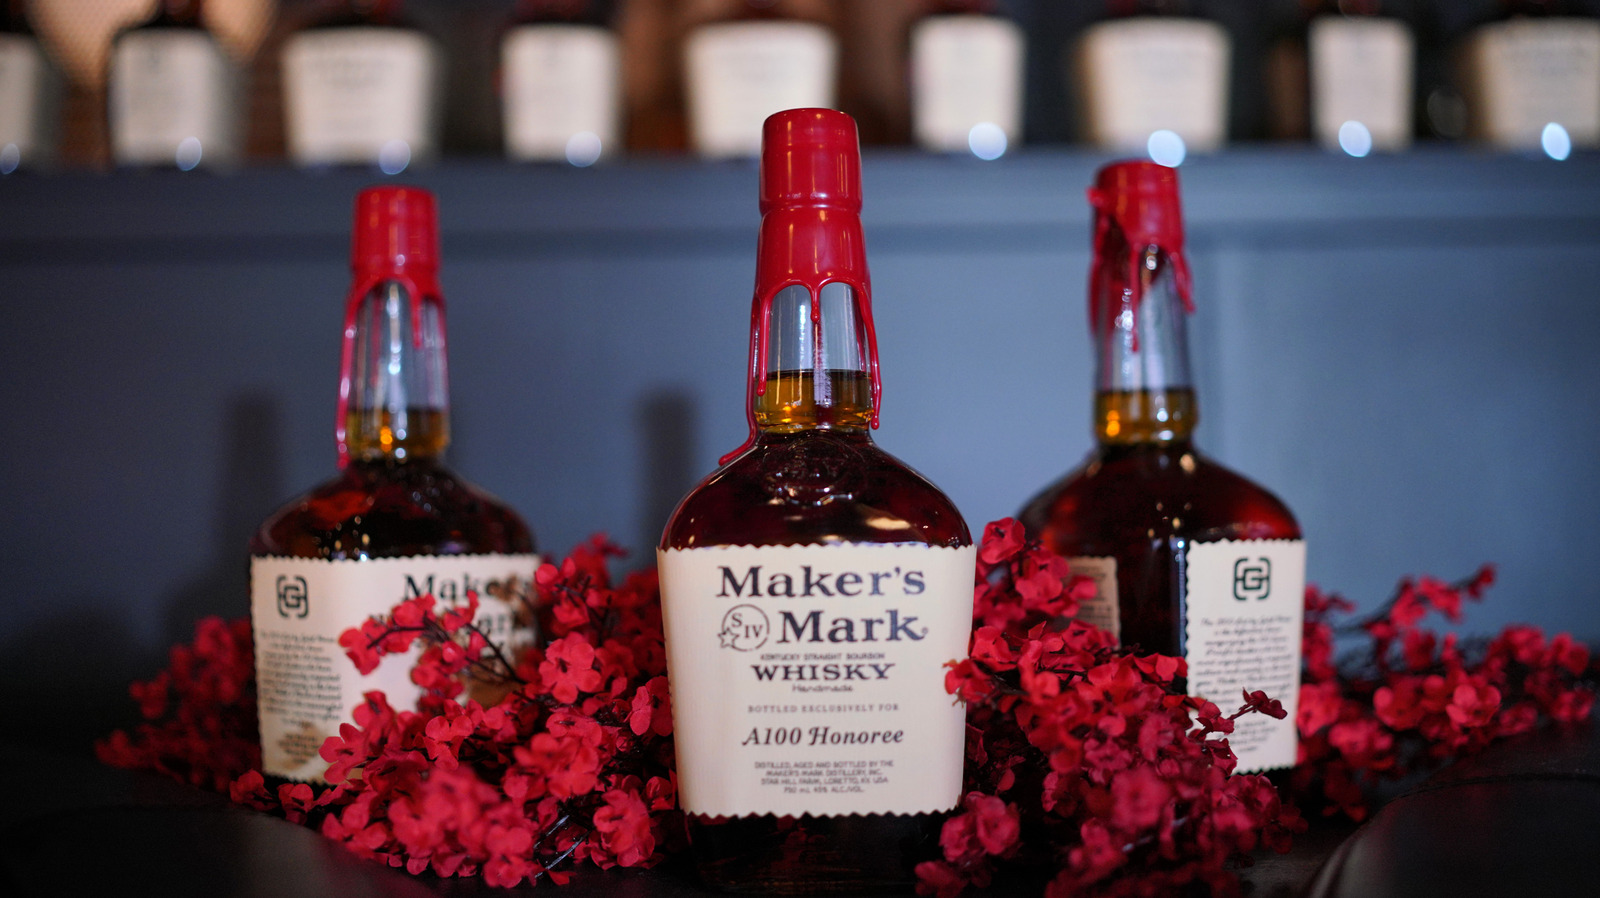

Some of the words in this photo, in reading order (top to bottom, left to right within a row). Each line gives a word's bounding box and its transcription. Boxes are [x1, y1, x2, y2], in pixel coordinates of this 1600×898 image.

[715, 564, 927, 599] Maker's
[760, 653, 801, 661] KENTUCKY
[803, 652, 842, 661] STRAIGHT
[845, 652, 886, 661] BOURBON
[750, 663, 896, 682] WHISKY
[791, 684, 854, 693] Handmade
[747, 704, 798, 714] BOTTLED
[801, 703, 874, 714] EXCLUSIVELY
[878, 702, 900, 712] FOR
[741, 727, 803, 747] A100
[807, 726, 904, 746] Honoree
